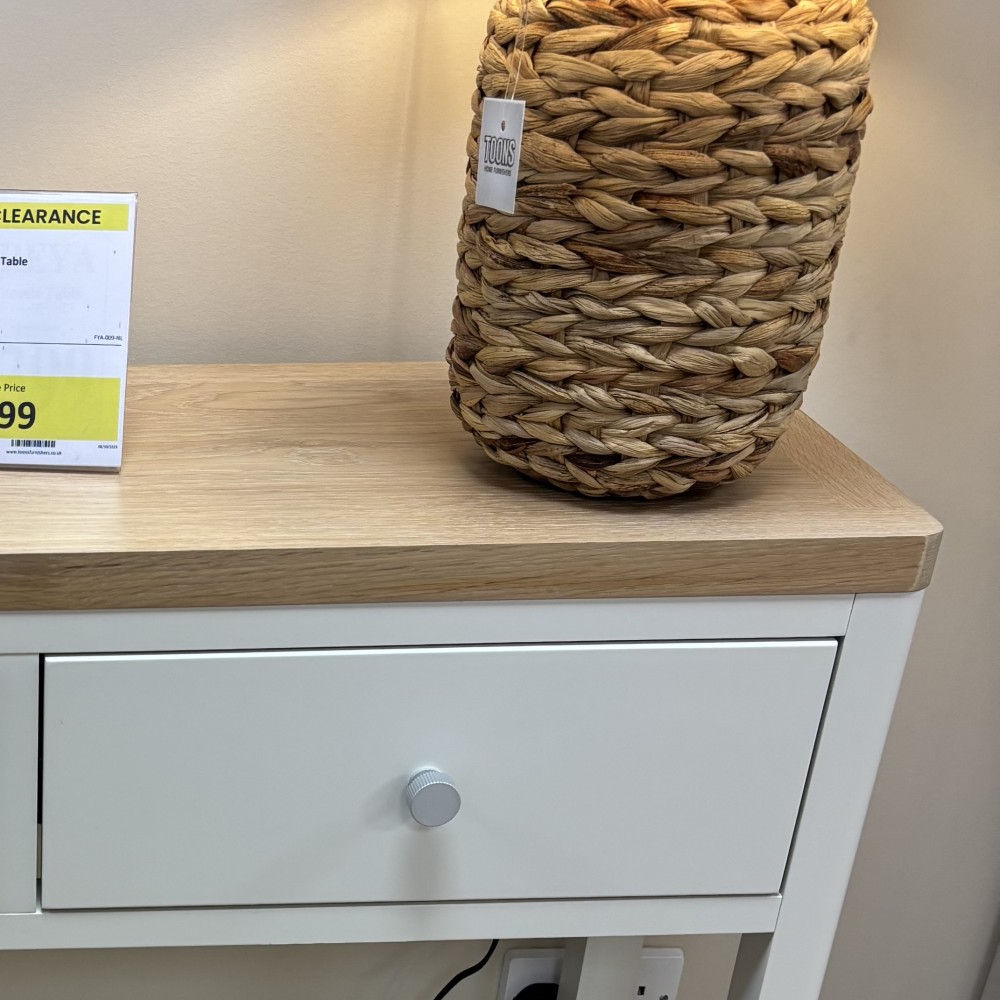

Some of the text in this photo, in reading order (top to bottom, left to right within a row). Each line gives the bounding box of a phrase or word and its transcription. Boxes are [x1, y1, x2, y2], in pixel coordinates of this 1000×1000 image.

[484, 135, 516, 167] TOONS
[0, 256, 28, 266] Table
[3, 383, 26, 393] Price
